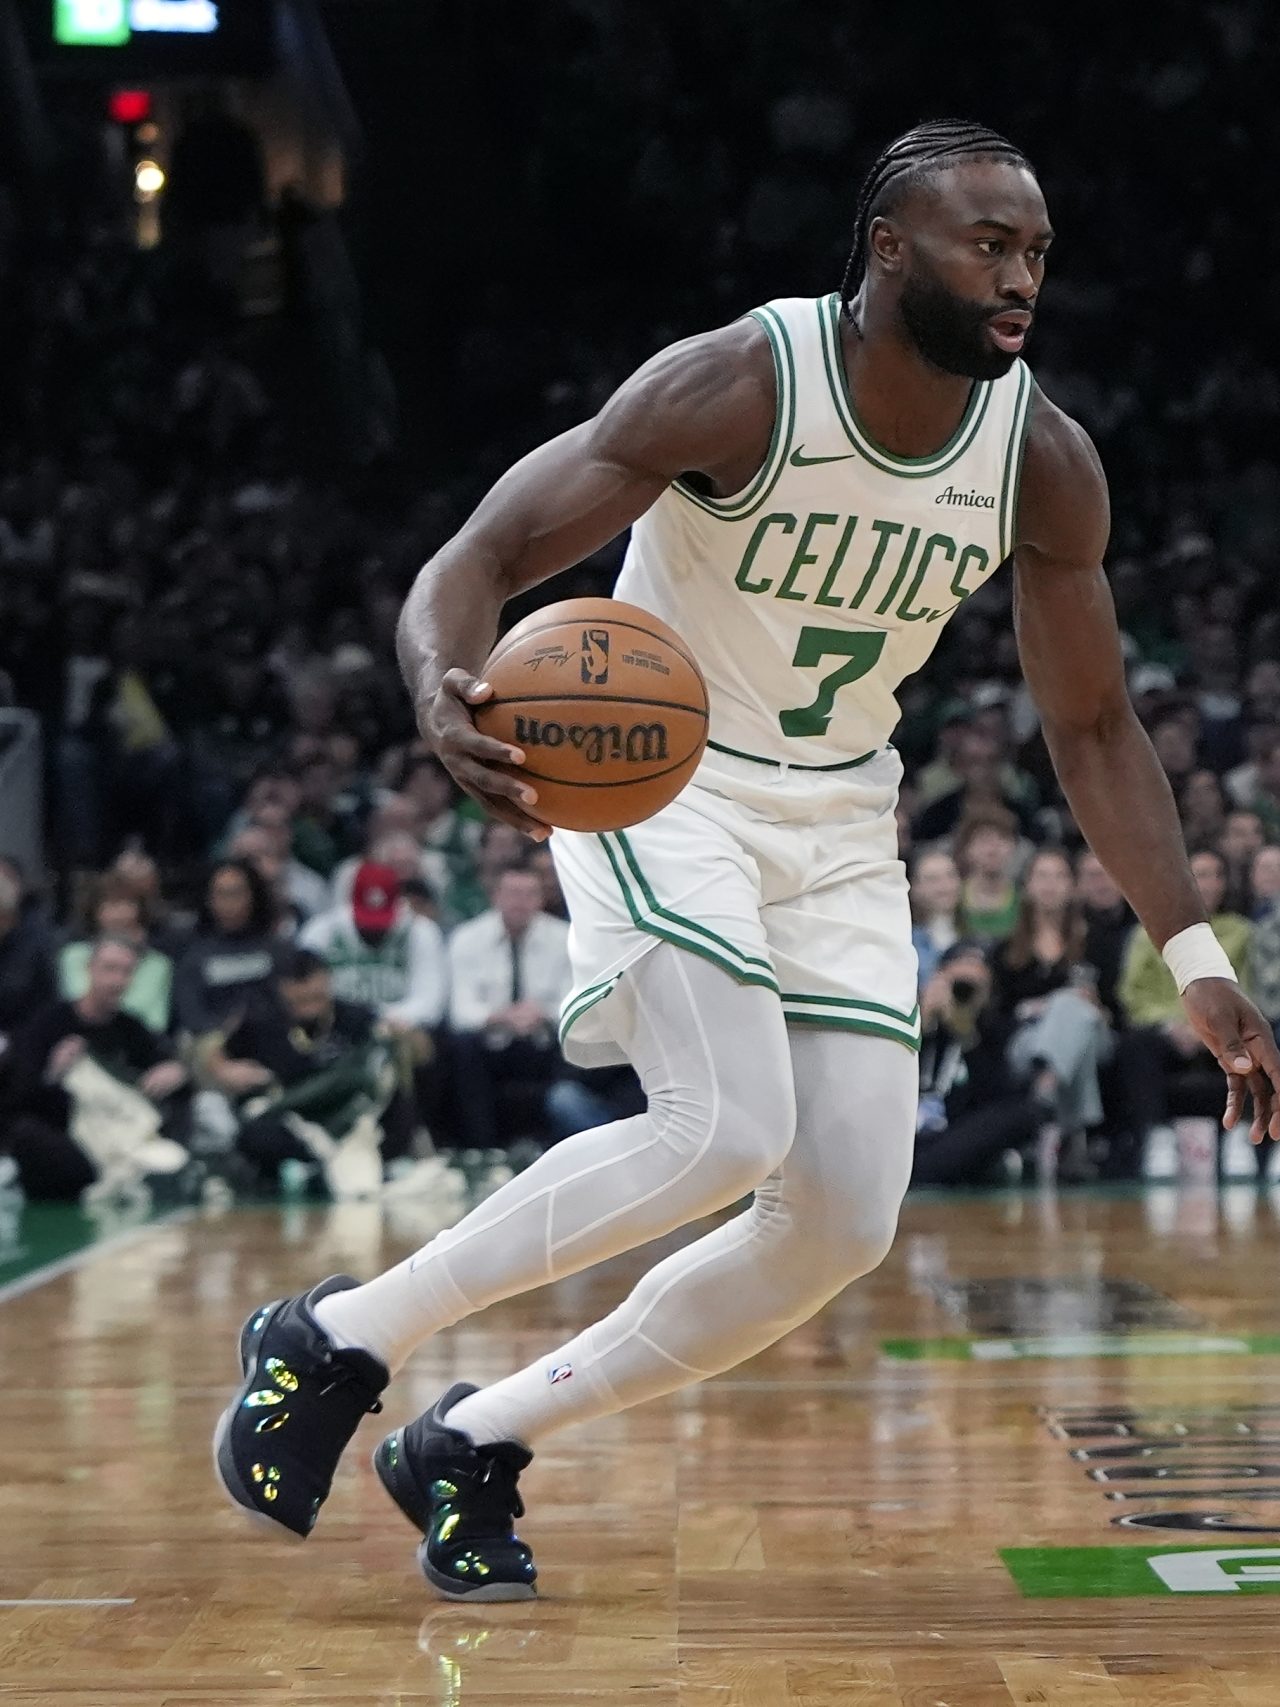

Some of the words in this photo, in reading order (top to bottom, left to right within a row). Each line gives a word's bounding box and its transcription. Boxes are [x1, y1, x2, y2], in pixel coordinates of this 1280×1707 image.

[935, 485, 996, 509] Amica
[735, 512, 989, 623] CELTICS
[779, 626, 888, 738] 7
[514, 714, 669, 766] Wilson
